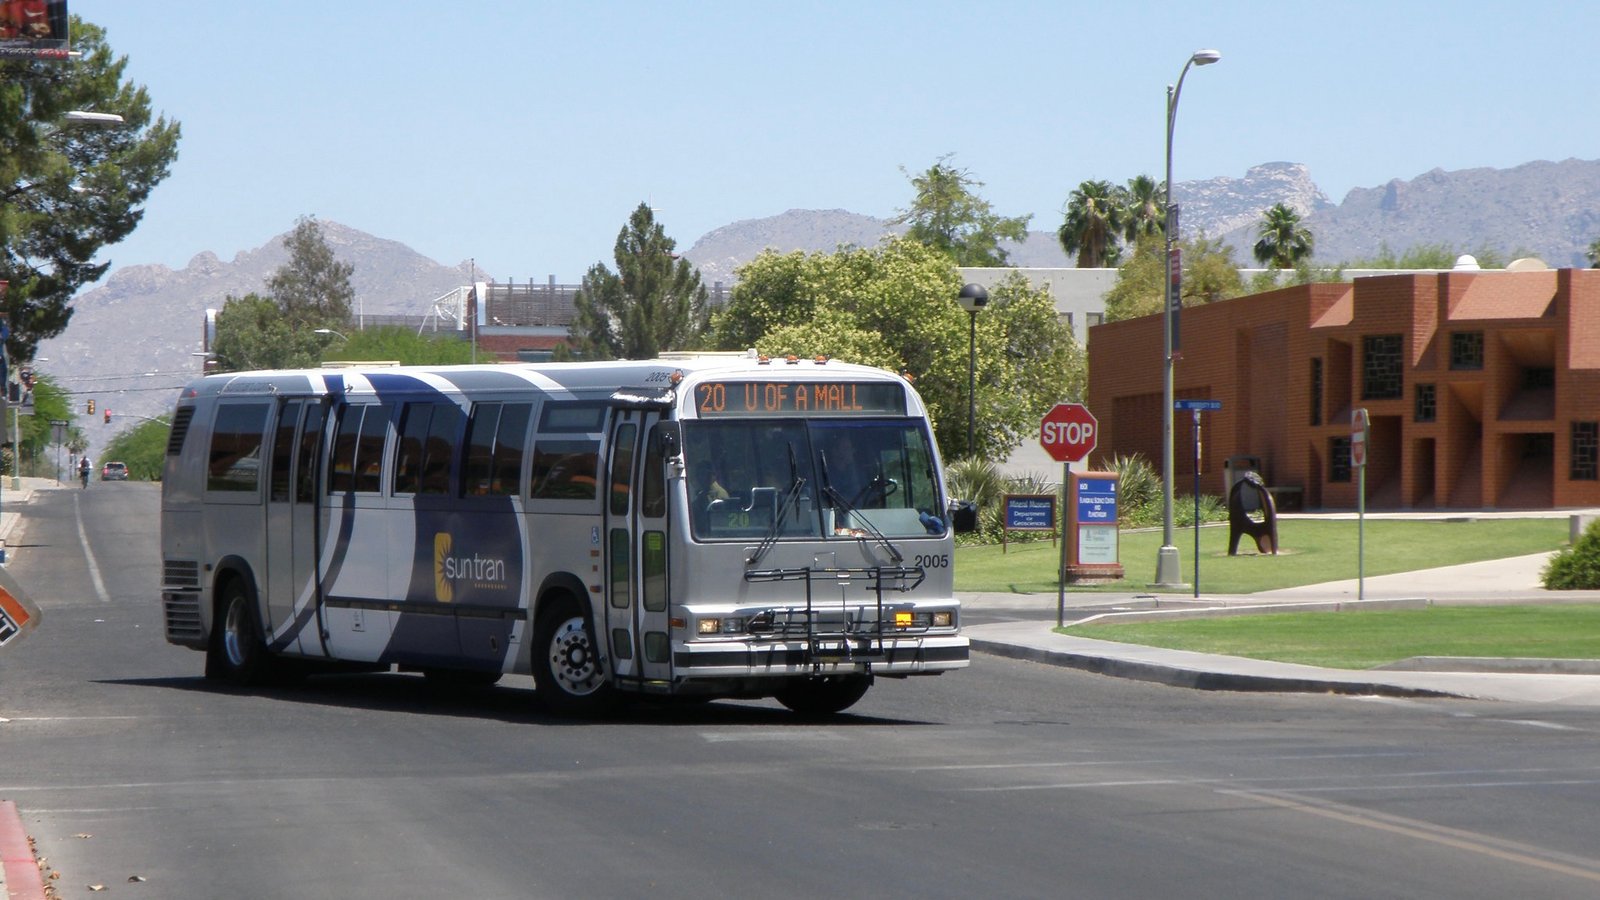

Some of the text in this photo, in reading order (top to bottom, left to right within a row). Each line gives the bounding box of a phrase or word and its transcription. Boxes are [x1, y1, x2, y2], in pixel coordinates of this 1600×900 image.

[700, 383, 863, 412] 20 U OF A MALL
[1043, 421, 1093, 445] STOP
[1029, 500, 1051, 508] Museum
[728, 512, 750, 528] 20
[1013, 510, 1046, 518] Department
[914, 554, 949, 569] 2005
